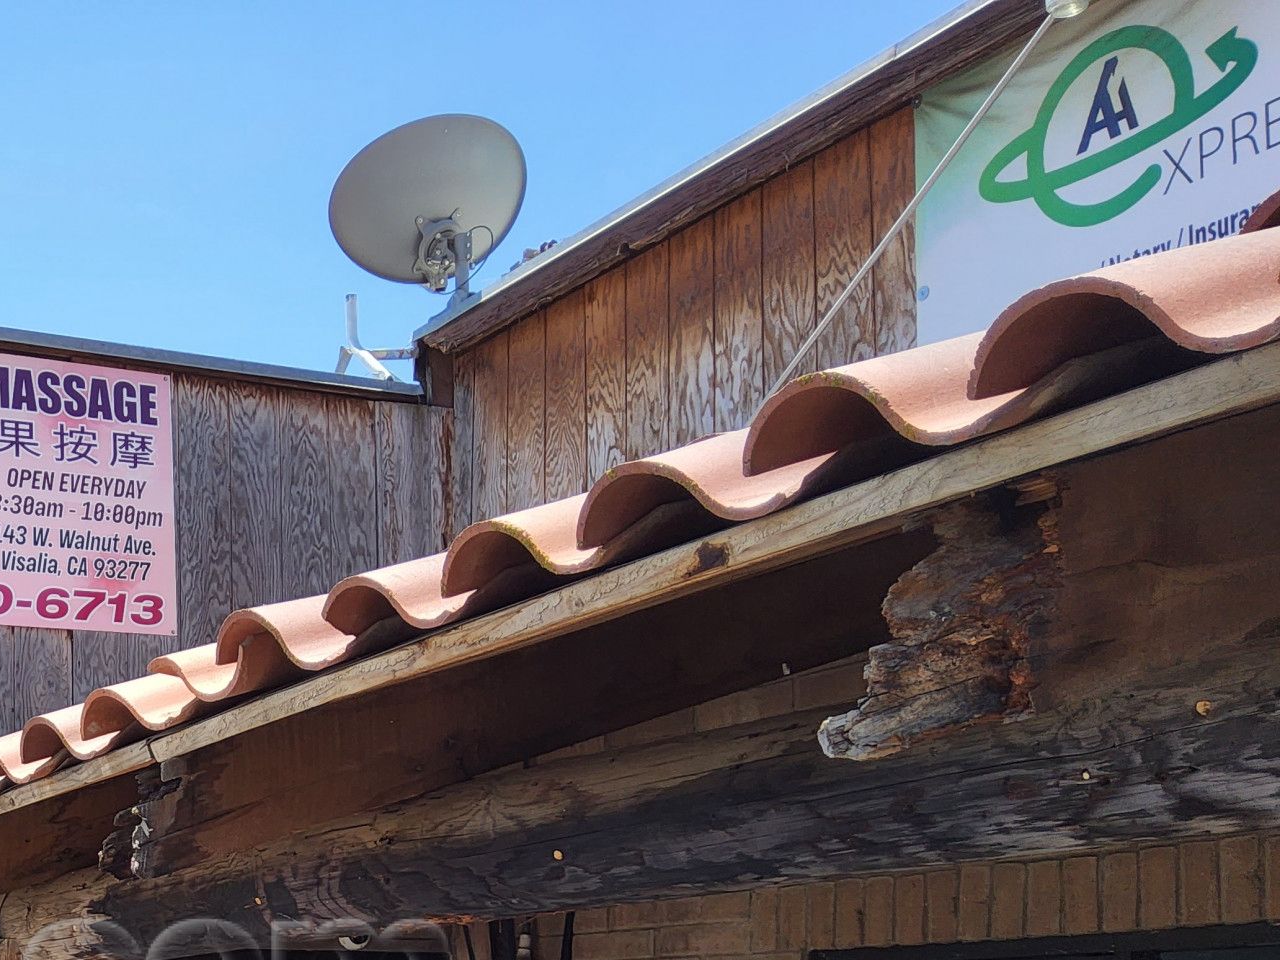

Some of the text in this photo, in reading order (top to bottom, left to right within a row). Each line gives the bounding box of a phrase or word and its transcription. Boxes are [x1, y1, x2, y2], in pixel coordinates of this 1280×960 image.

[7, 467, 147, 499] OPEN EVERYDAY
[81, 501, 163, 530] 10:00pm
[32, 526, 53, 548] W.
[59, 529, 120, 553] Walnut
[123, 535, 156, 556] Ave.
[1, 550, 151, 581] Visalia, CA 93277
